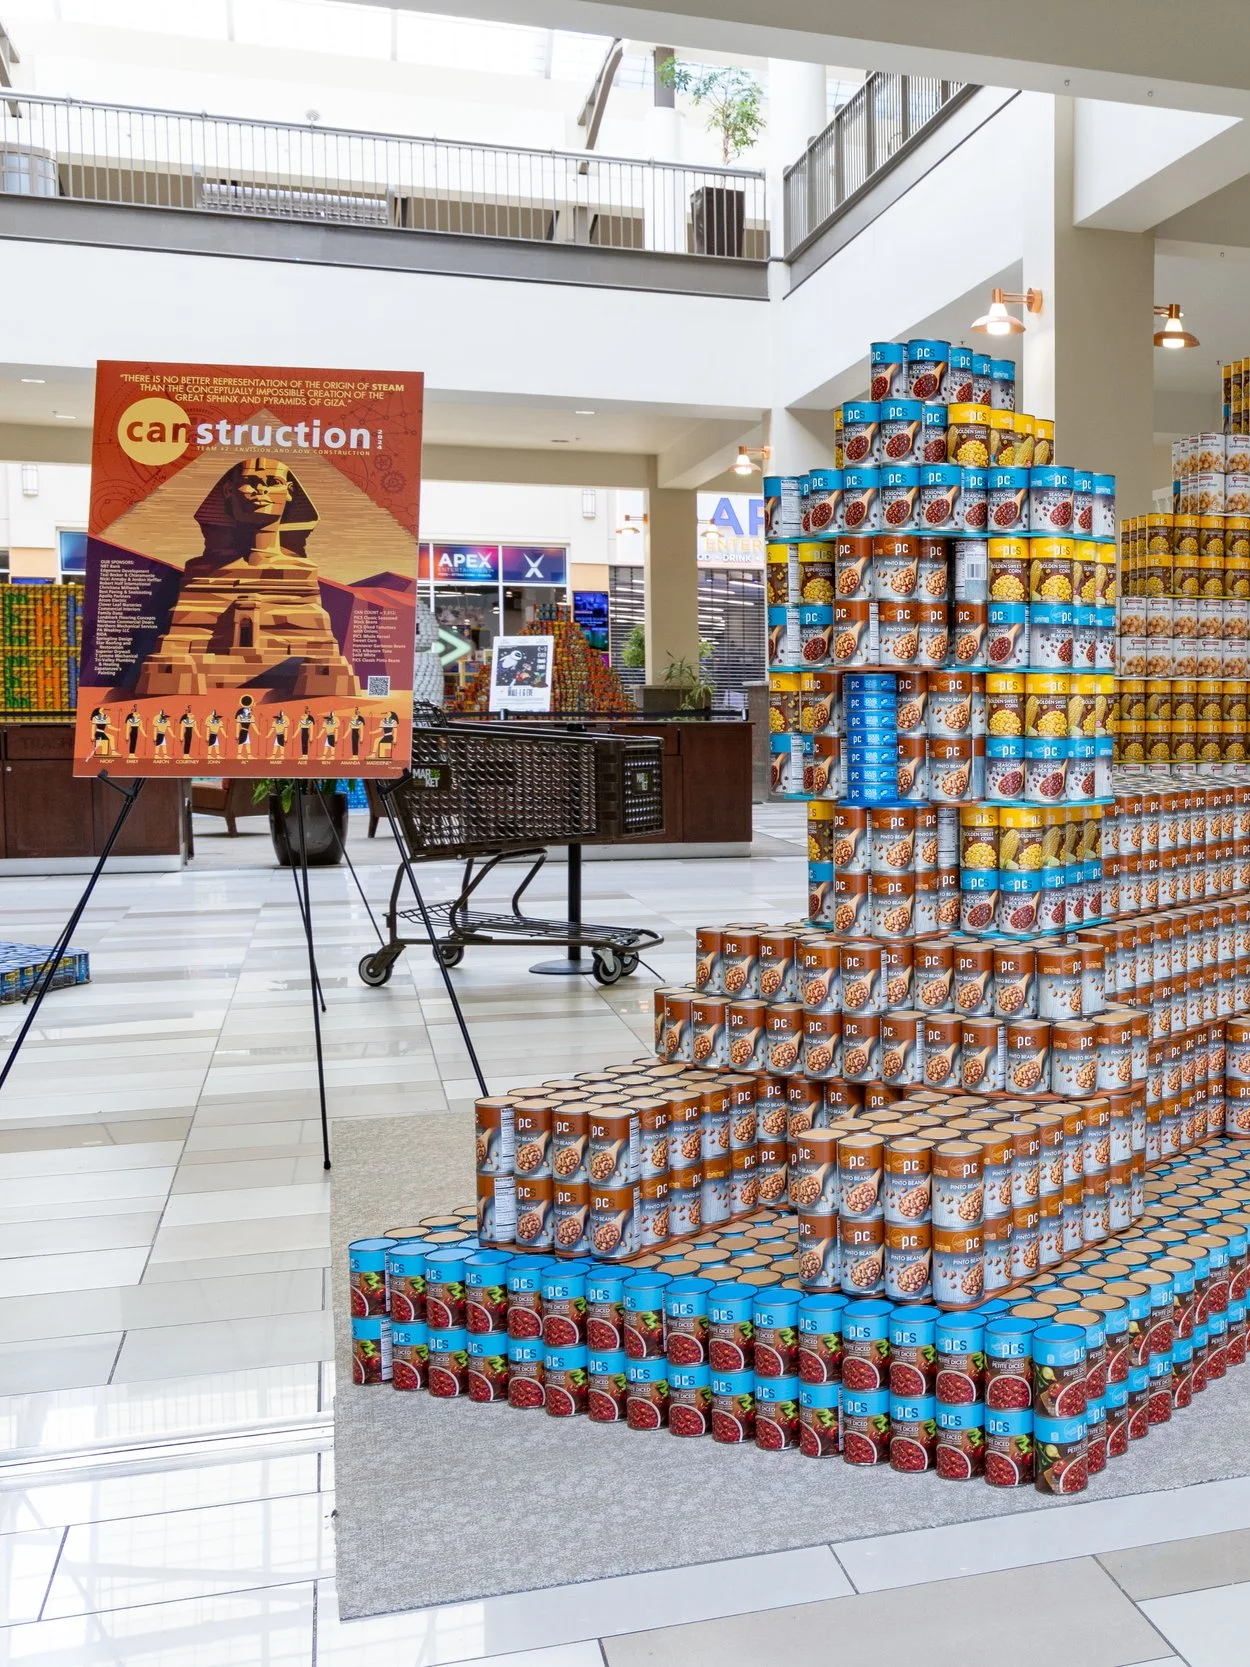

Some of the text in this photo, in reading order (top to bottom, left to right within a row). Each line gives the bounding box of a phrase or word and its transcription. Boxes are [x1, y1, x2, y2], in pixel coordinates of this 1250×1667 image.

[140, 383, 384, 400] THAN THE CONCEPTUALLY IMPOSSIBLE CREATION OF THE
[153, 375, 161, 384] IS
[163, 376, 178, 384] NO
[181, 376, 210, 385] BETTER
[213, 377, 288, 388] REPRESENTATION
[290, 380, 302, 388] OF
[305, 380, 320, 389] THE
[323, 381, 355, 390] ORIGIN
[357, 382, 369, 390] OF
[371, 383, 405, 392] STEAM
[174, 393, 204, 402] GREAT
[206, 394, 238, 403] SPHINX
[240, 395, 260, 404] AND
[263, 396, 306, 406] PYRAMIDS
[309, 398, 321, 406] OF
[126, 418, 370, 449] canstruction
[438, 551, 492, 569] APEX
[723, 553, 751, 562] DRINK
[896, 1329, 917, 1345] pics
[945, 1338, 967, 1353] pics
[1002, 1341, 1025, 1358] pics
[897, 1404, 918, 1420] pics
[942, 1412, 962, 1427] pics
[989, 1418, 1010, 1434] pics
